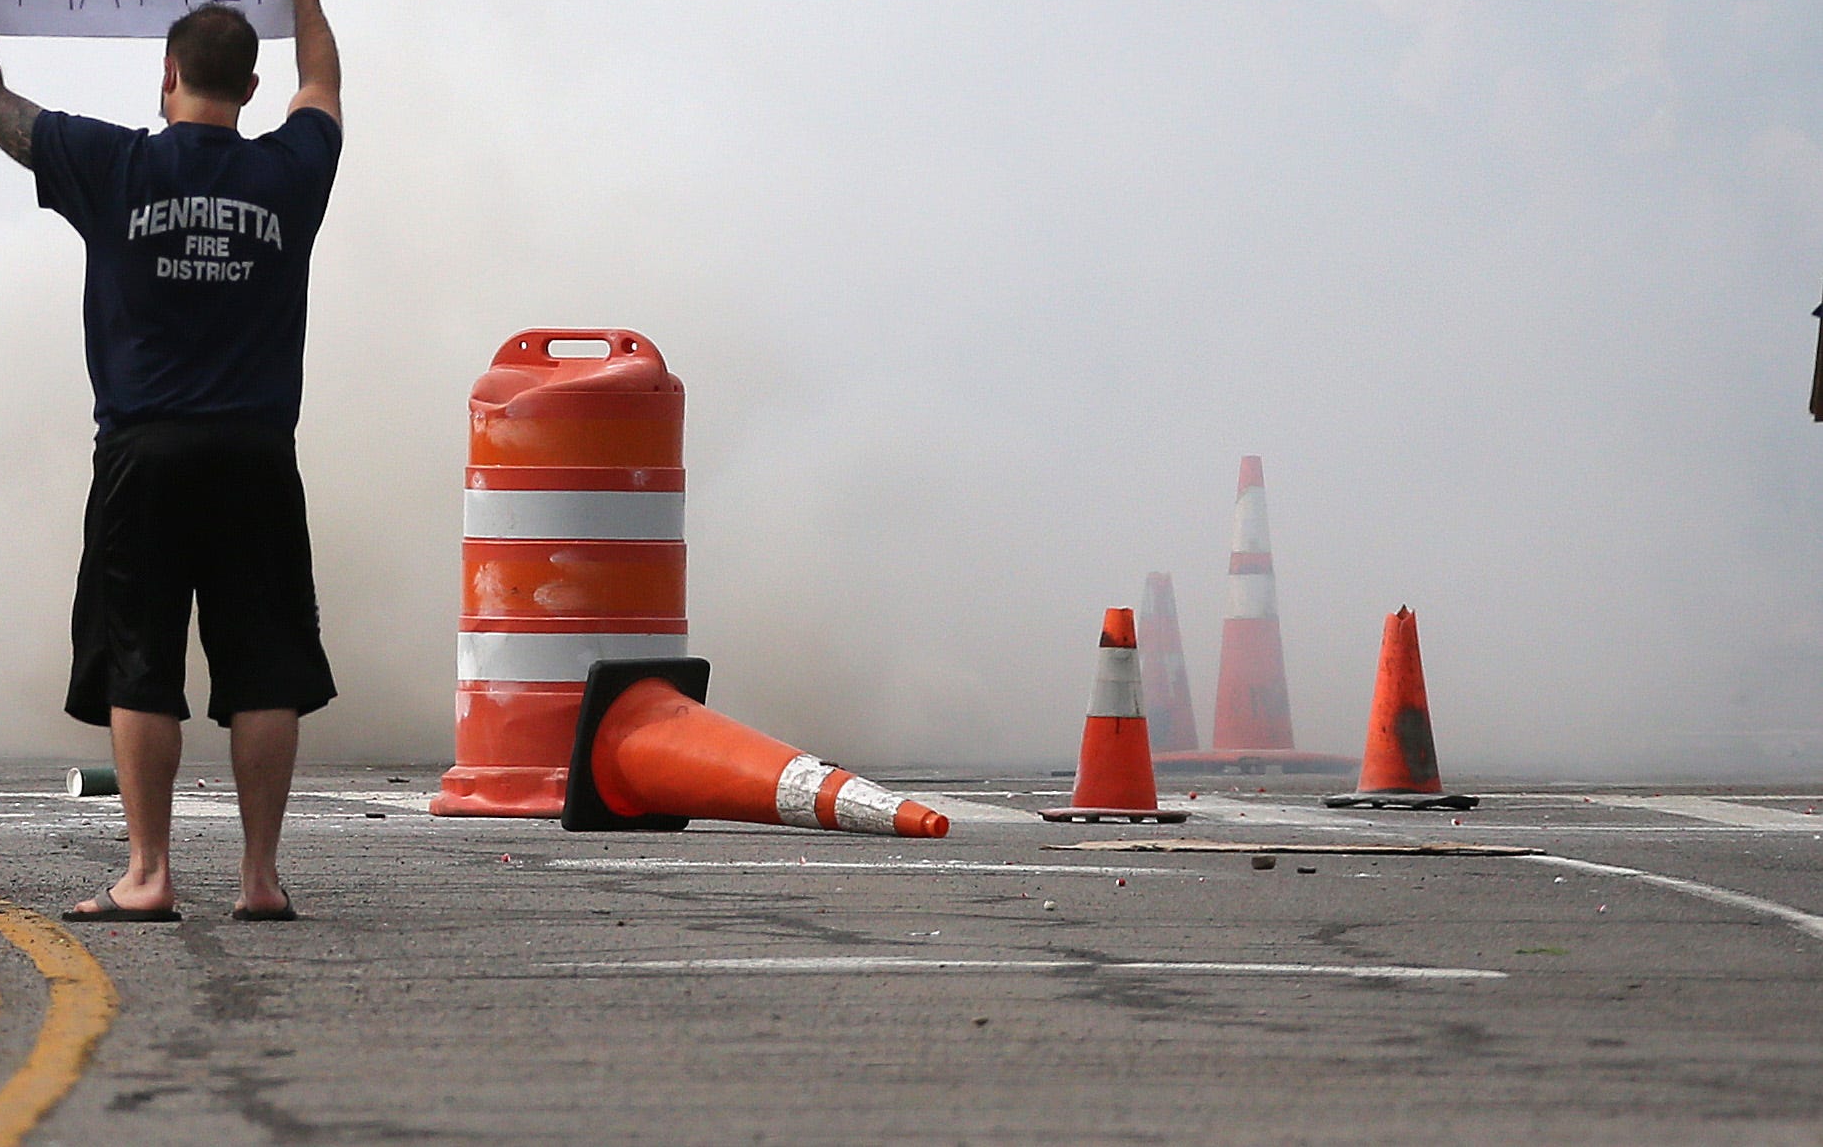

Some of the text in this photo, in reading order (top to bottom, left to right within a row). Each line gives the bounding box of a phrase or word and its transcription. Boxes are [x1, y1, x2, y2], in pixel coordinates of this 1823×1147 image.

[128, 196, 283, 251] HENRIETTA
[185, 235, 230, 257] FIRE
[156, 257, 255, 282] DISTRICT
